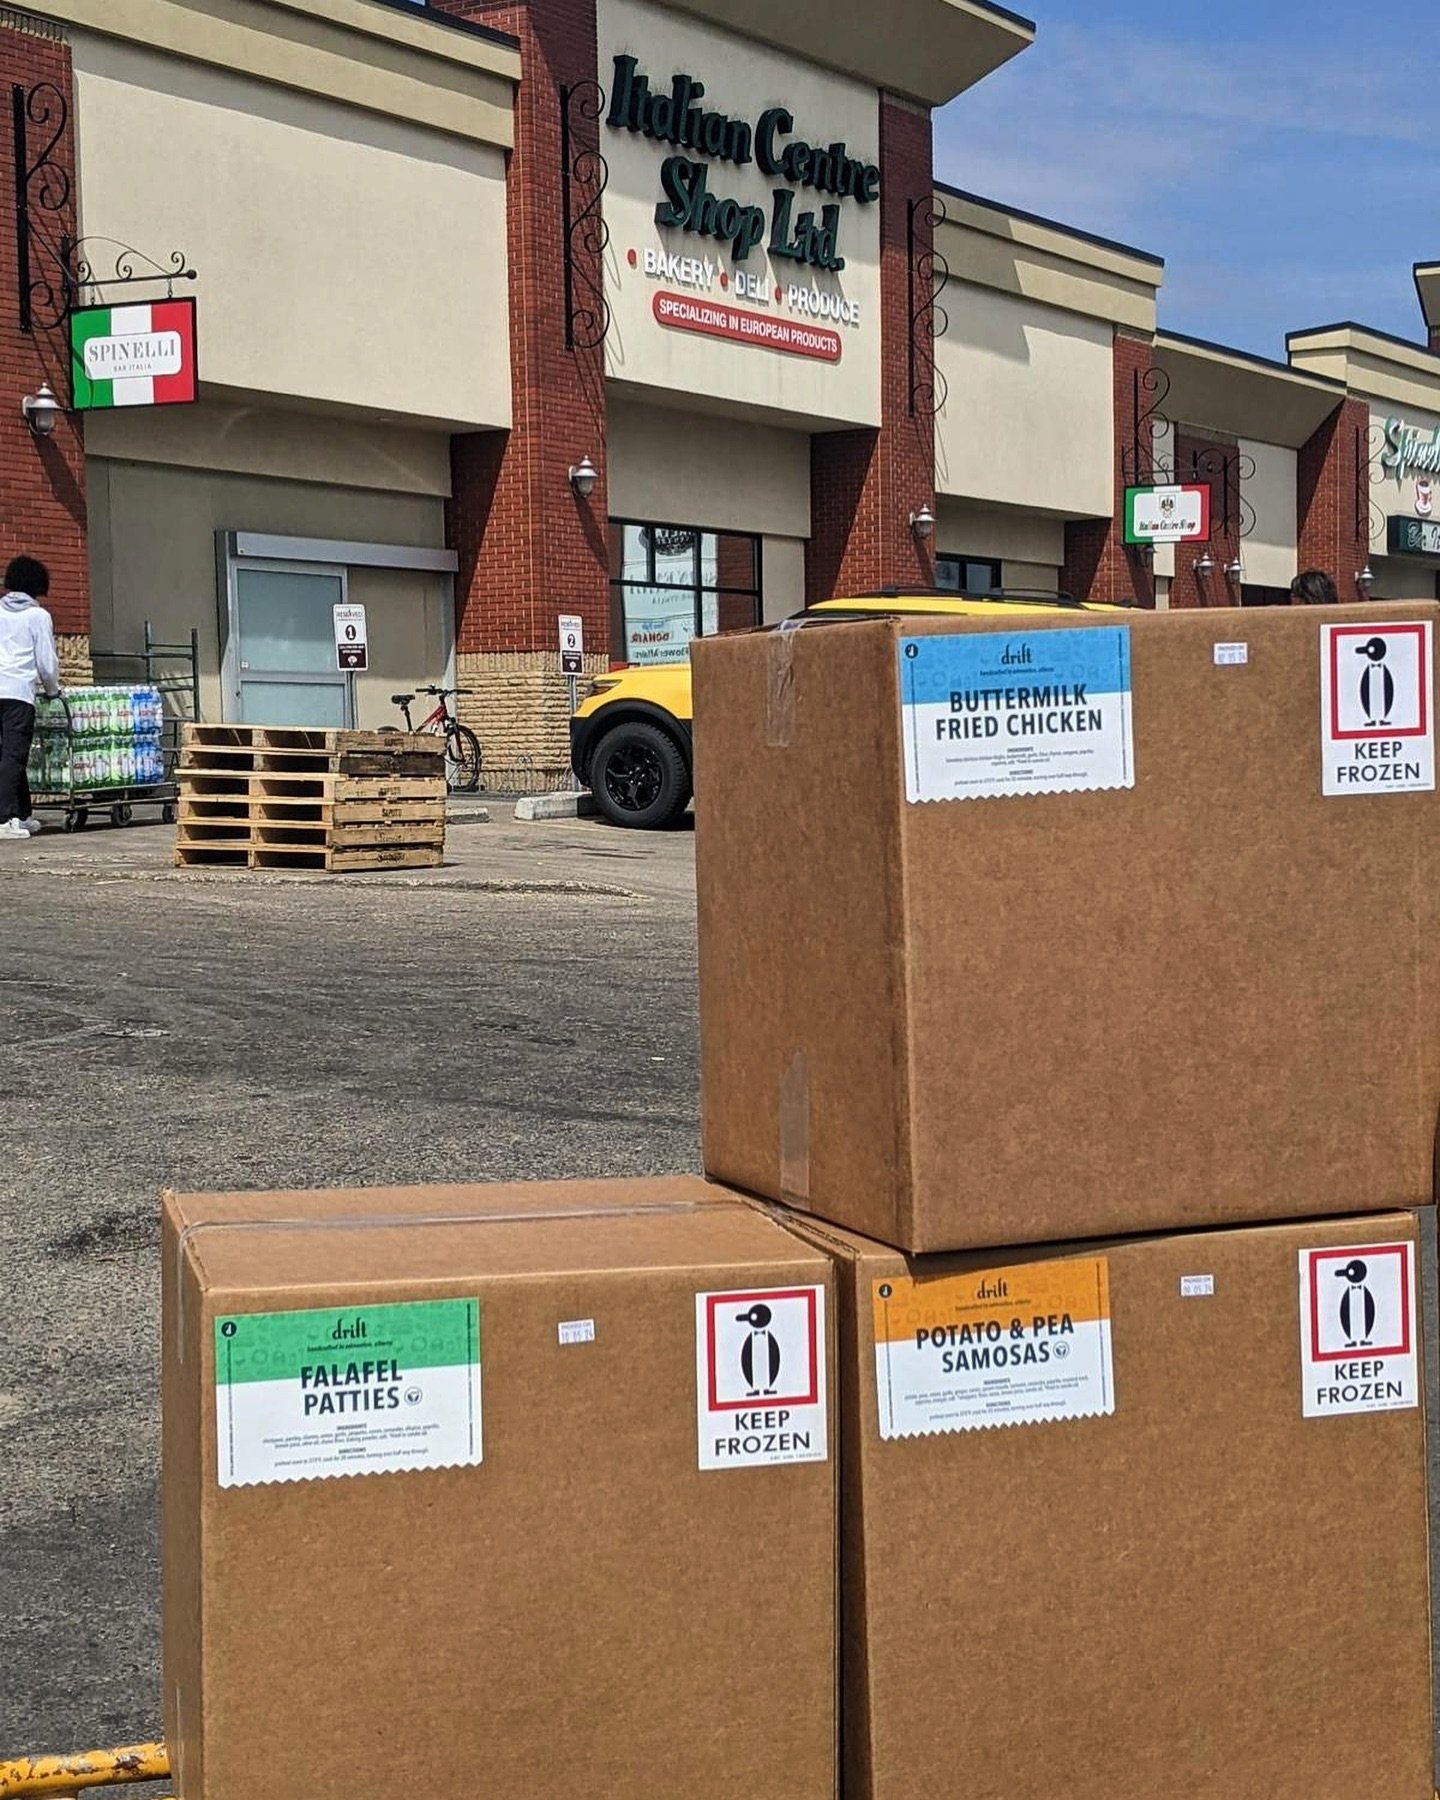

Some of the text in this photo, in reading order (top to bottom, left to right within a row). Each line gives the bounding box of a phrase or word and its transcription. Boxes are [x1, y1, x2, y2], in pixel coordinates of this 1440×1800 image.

[606, 55, 879, 203] Italian Centre
[655, 156, 845, 272] Shop Ltd.
[643, 249, 860, 324] BAKERY DELI PRODUCE
[659, 298, 838, 352] SPECIALIZING IN EUROPEAN PRODUCTS
[89, 339, 175, 363] SPINELLI
[347, 626, 354, 639] 1
[568, 635, 574, 647] 2
[1001, 642, 1033, 665] drift
[949, 683, 1088, 713] BUTTERMILK
[935, 709, 1103, 741] FRIED CHICKEN
[1354, 741, 1403, 760] KEEP
[1336, 762, 1420, 784] FROZEN
[977, 1277, 1008, 1299] drift
[332, 1316, 367, 1340] drift
[916, 1313, 1075, 1350] POTATO & PEA
[942, 1341, 1050, 1373] SAMOSAS
[301, 1359, 402, 1389] FALAFEL
[1334, 1361, 1384, 1381] KEEP
[304, 1387, 400, 1416] PATTIES
[1317, 1381, 1402, 1405] FROZEN
[734, 1410, 790, 1431] KEEP
[715, 1432, 811, 1456] FROZEN
